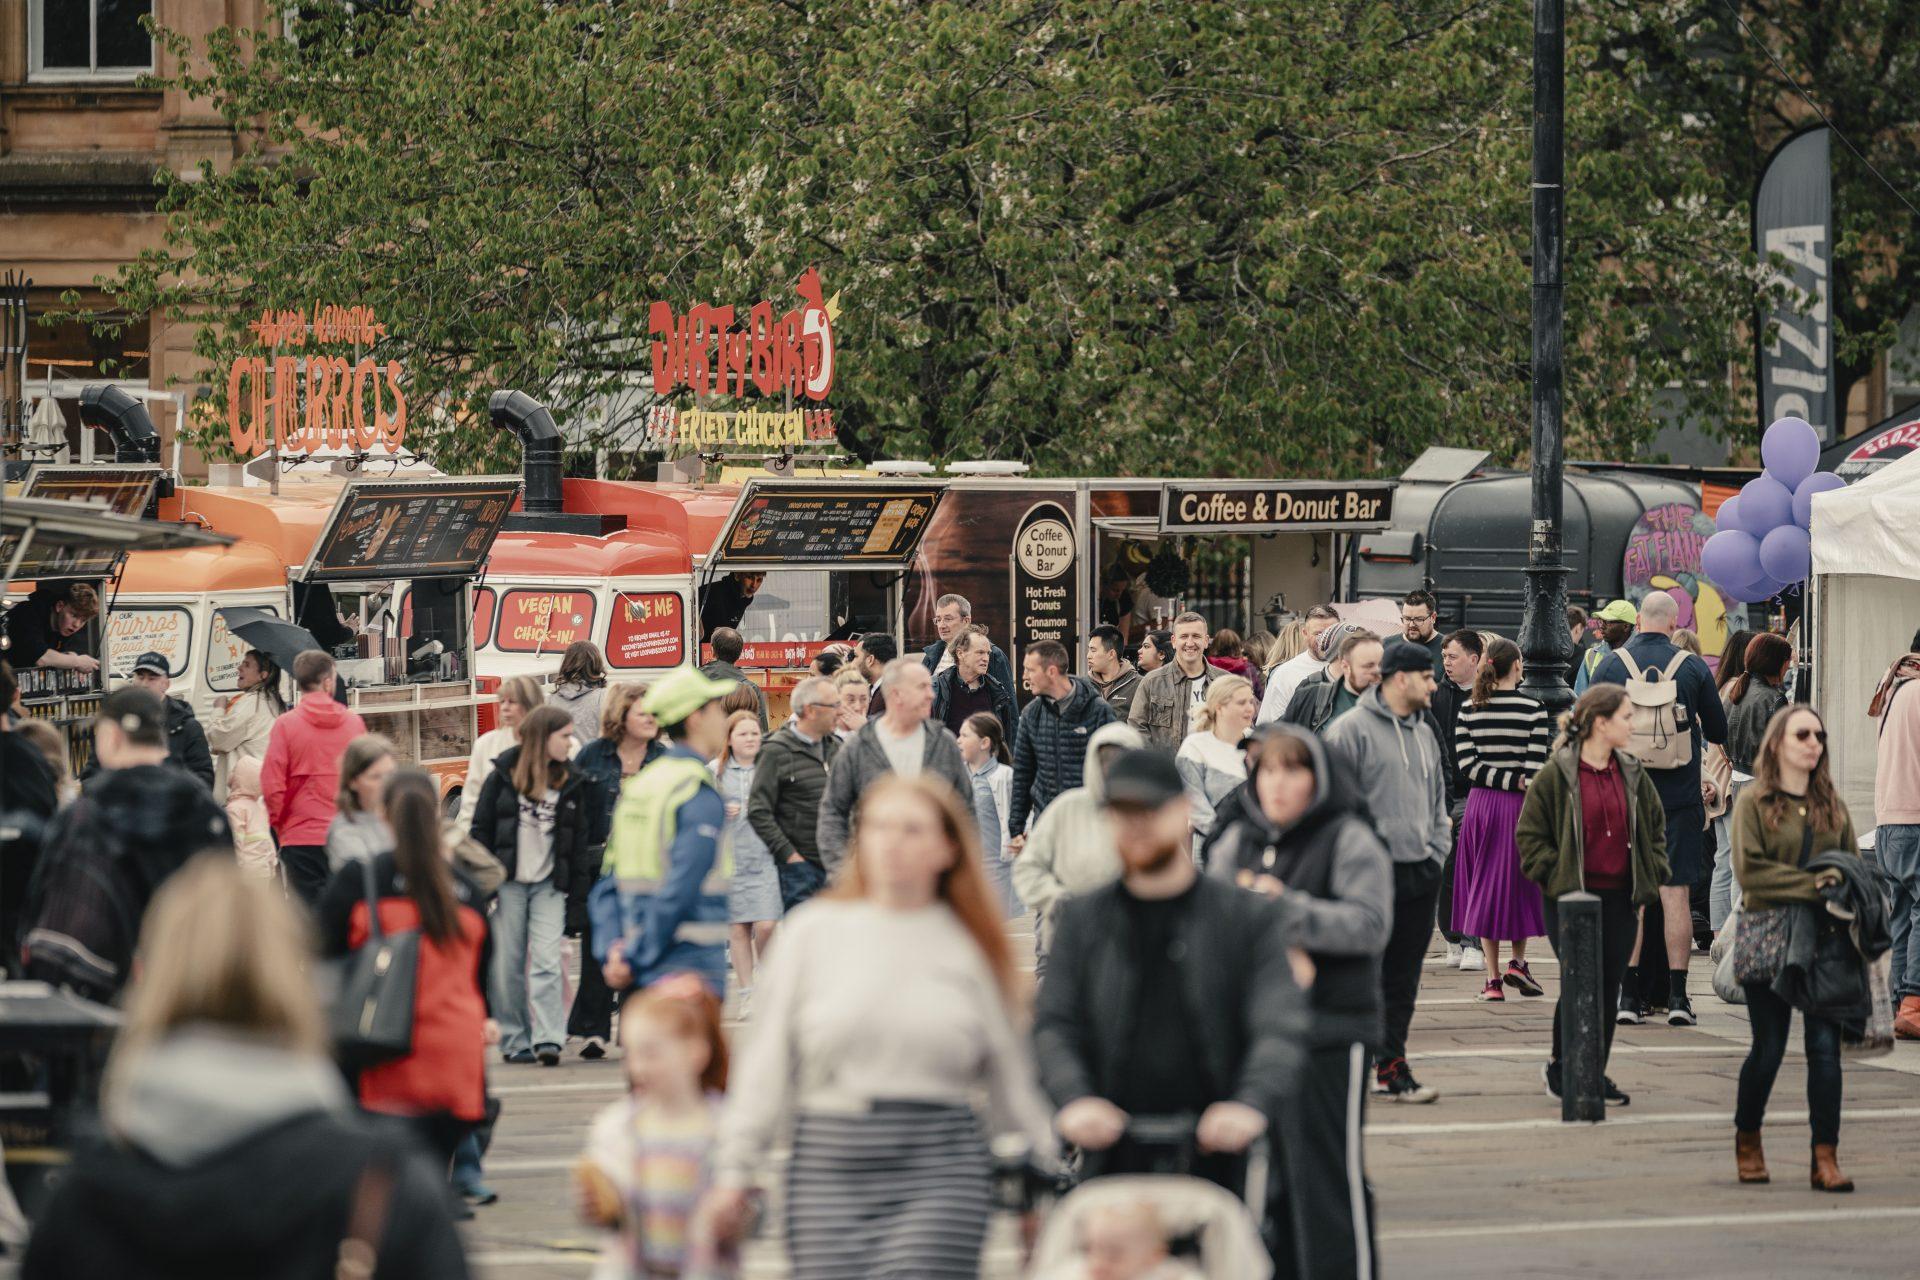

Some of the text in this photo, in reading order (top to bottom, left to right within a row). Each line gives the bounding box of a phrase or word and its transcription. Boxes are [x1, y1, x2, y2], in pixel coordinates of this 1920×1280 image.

[227, 354, 407, 457] CHURROS
[680, 406, 804, 451] FRIED CHICKEN
[1179, 491, 1381, 523] Coffee & Donut Bar
[1646, 504, 1696, 532] THE
[1030, 528, 1063, 541] Coffee
[1025, 544, 1068, 557] & Donut
[1625, 529, 1707, 584] FAT FLAM
[1037, 559, 1055, 571] Bar
[1025, 586, 1067, 598] Hot Fresh
[518, 595, 573, 614] VEGAN
[624, 597, 674, 624] HE ME
[1031, 599, 1061, 611] Donuts
[1025, 615, 1067, 628] Cinnamon
[513, 626, 575, 645] CHICK-IN!
[1031, 629, 1061, 640] Donuts
